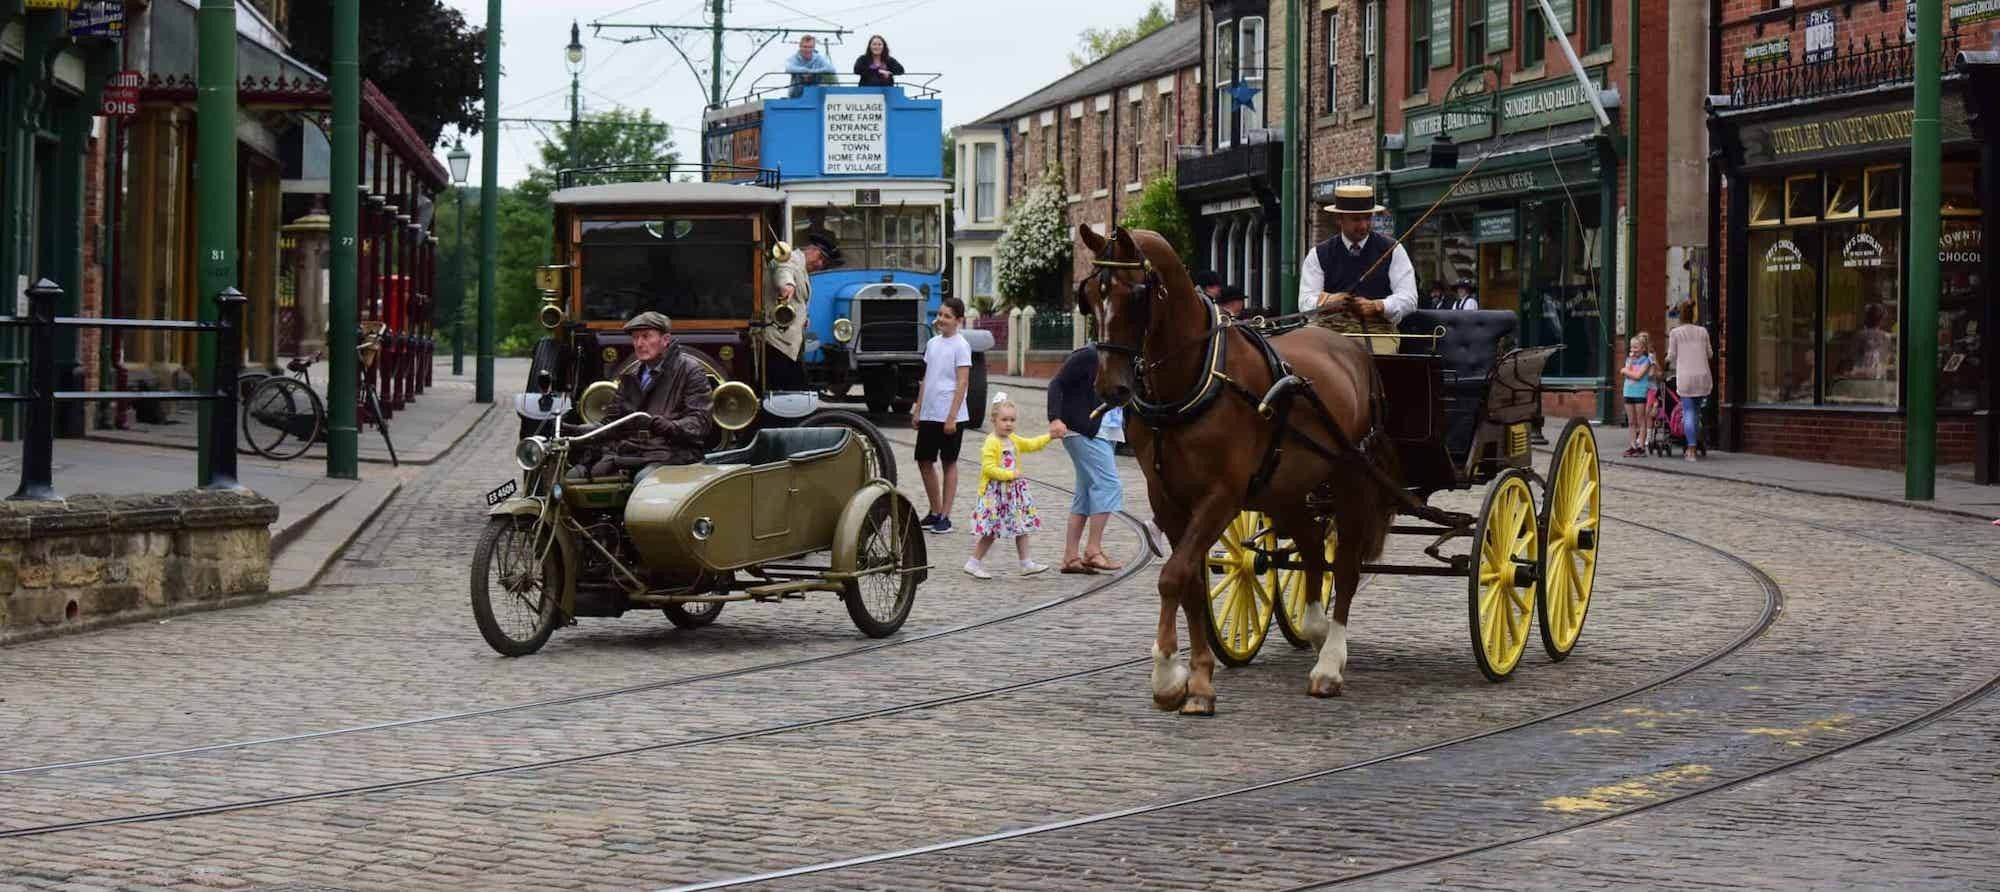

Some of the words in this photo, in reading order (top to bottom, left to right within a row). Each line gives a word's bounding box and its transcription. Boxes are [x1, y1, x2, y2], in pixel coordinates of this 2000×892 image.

[1504, 89, 1555, 119] SUNDERLAND
[1555, 83, 1579, 109] DAILY
[104, 100, 137, 114] Oils
[827, 103, 841, 111] PIT
[845, 103, 883, 111] VILLAGE
[828, 113, 855, 121] HOME
[857, 113, 882, 121] FARM
[1448, 109, 1468, 130] DAILY
[830, 123, 880, 131] ENTRANCE
[828, 133, 882, 142] POCKERLEY
[1774, 122, 1823, 154] JUBILEE
[842, 143, 870, 151] TOWN
[828, 153, 855, 161] HOME
[857, 153, 881, 161] FARM
[844, 163, 882, 171] VILLAGE
[1509, 171, 1534, 188] OFFICE
[865, 192, 871, 201] 3
[342, 238, 353, 246] 77
[1938, 252, 1981, 263] CHOCOL
